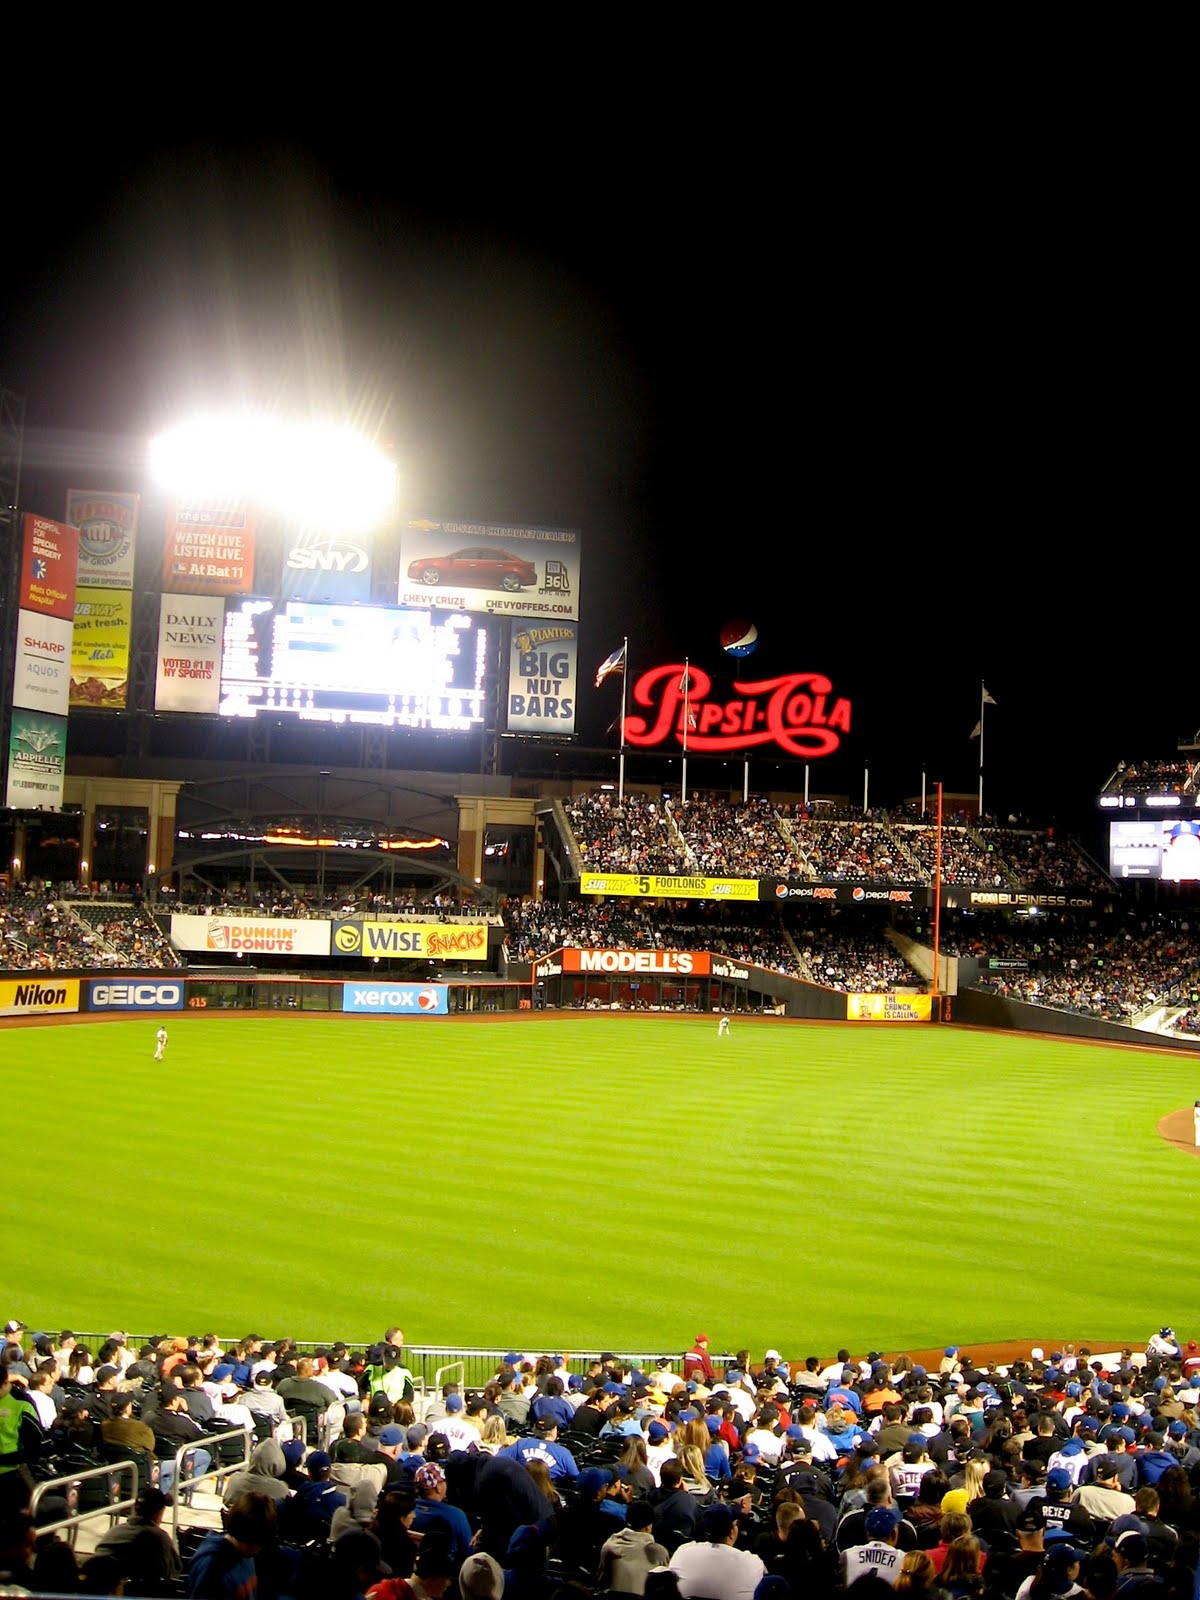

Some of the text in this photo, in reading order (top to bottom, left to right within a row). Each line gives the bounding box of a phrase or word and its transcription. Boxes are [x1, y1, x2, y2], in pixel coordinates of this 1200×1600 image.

[33, 519, 60, 534] HOSPITAL
[33, 528, 46, 538] FOR
[32, 537, 58, 551] SPECIAL
[175, 532, 245, 548] WATCH LIVE.
[32, 546, 61, 560] SURGERY
[174, 545, 244, 561] LISTEN LIVE.
[189, 563, 243, 578] At Bat 11
[545, 575, 561, 588] 36
[403, 594, 466, 606] CHEVY CRUZE
[486, 599, 573, 614] CHEVYOFFERS.COM
[74, 603, 122, 617] UBWAY
[73, 618, 127, 629] eat fresh.
[166, 614, 217, 627] DAILY
[165, 632, 216, 644] NEWS
[530, 627, 574, 641] PLANTERS
[24, 637, 65, 653] SHARP
[27, 663, 59, 678] AQUOS
[163, 658, 214, 670] VOTED #1 IN
[519, 651, 570, 679] BIG
[163, 668, 212, 680] NY SPORTS
[527, 679, 562, 695] NUT
[510, 694, 573, 719] BARS
[15, 751, 61, 765] ARPIELLE
[585, 878, 632, 891] SUBWAY
[655, 877, 706, 890] FOOTLONGS
[711, 883, 756, 896] SUBWAY
[789, 887, 913, 902] pepsi MAX pepsi MAX
[970, 892, 998, 905] FOX
[231, 926, 297, 939] DUNKIN'
[231, 938, 294, 951] DONUTS
[426, 928, 484, 956] SNACKS
[580, 950, 694, 974] MODELL'S
[712, 963, 749, 980] Mo's Zone
[14, 984, 67, 1007] Nikon
[92, 985, 180, 1006] GEICO
[354, 990, 414, 1006] xerox
[884, 1003, 912, 1011] CRUNCH
[892, 1011, 919, 1019] CALLING
[1041, 1505, 1071, 1520] REYES
[858, 1549, 897, 1568] SNIDER
